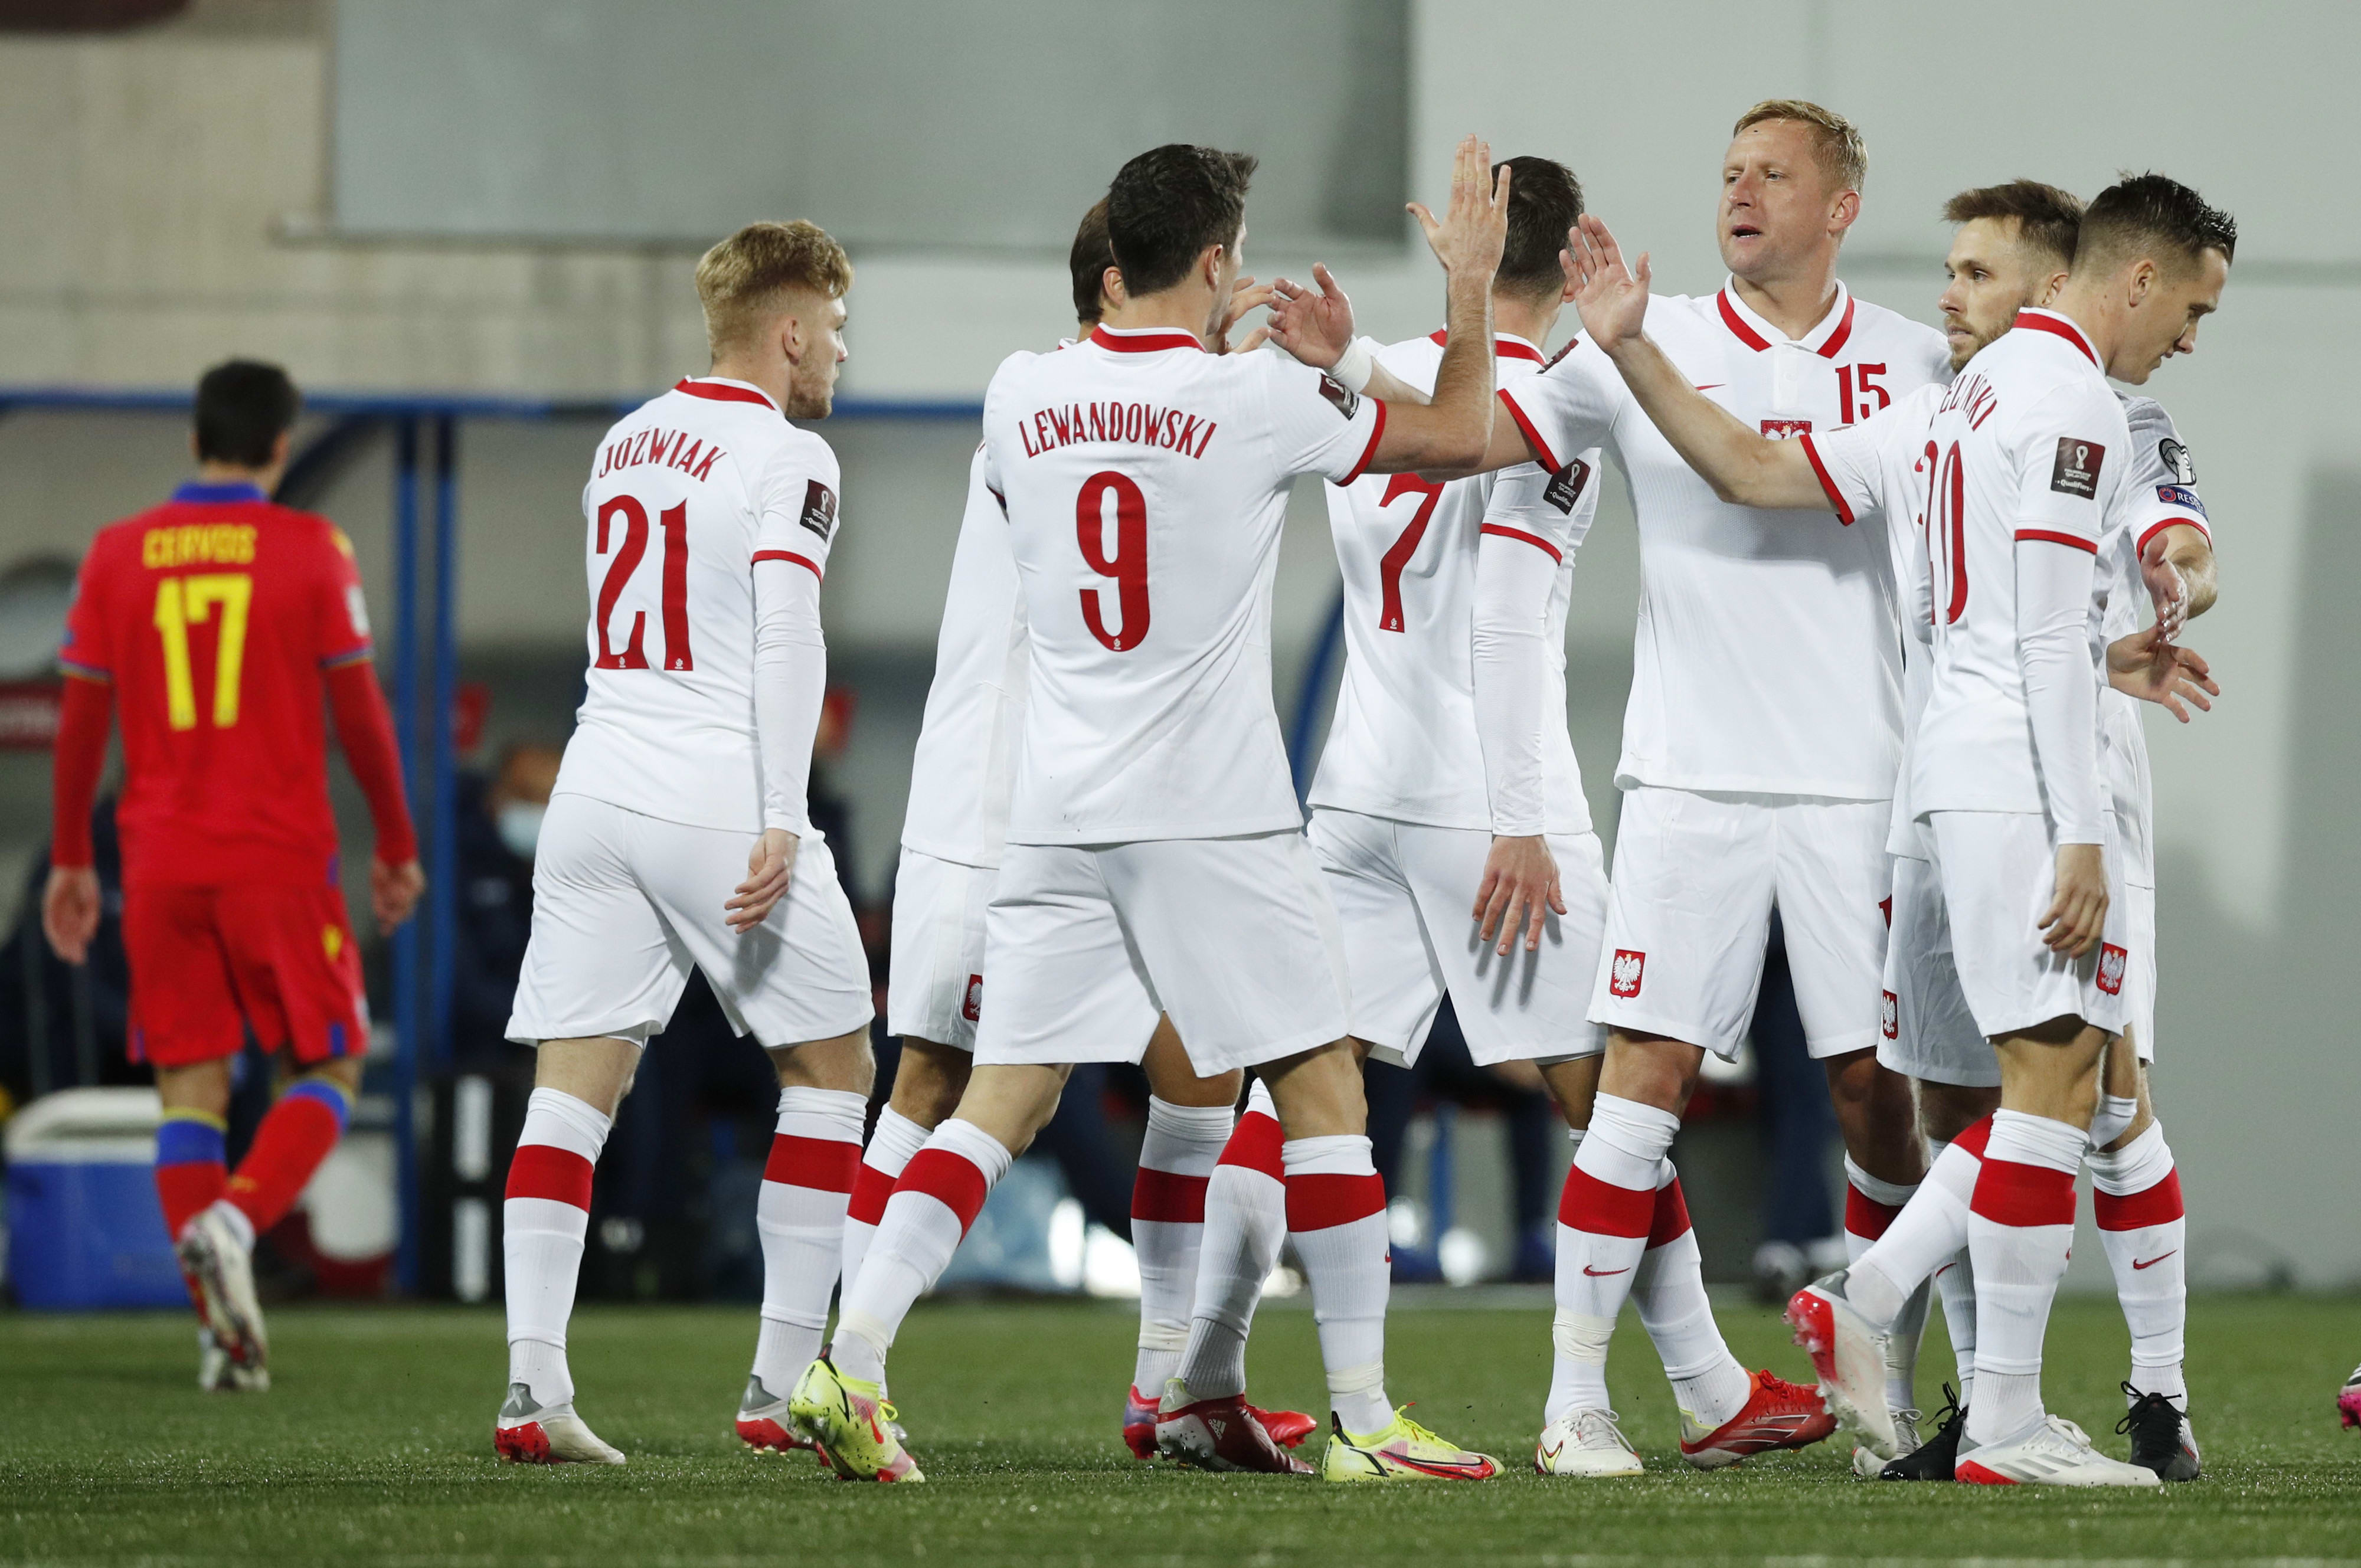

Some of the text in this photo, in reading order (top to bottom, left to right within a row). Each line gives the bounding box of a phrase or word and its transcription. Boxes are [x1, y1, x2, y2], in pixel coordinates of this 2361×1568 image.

[1019, 402, 1217, 459] LEWANDOWSKI
[1835, 362, 1891, 424] 15
[599, 424, 727, 482] JÓŹWIAK
[143, 524, 257, 568] CERVOS
[594, 495, 693, 671] 21
[1077, 470, 1150, 652] 9
[1378, 472, 1446, 633] 7
[153, 572, 253, 731] 17
